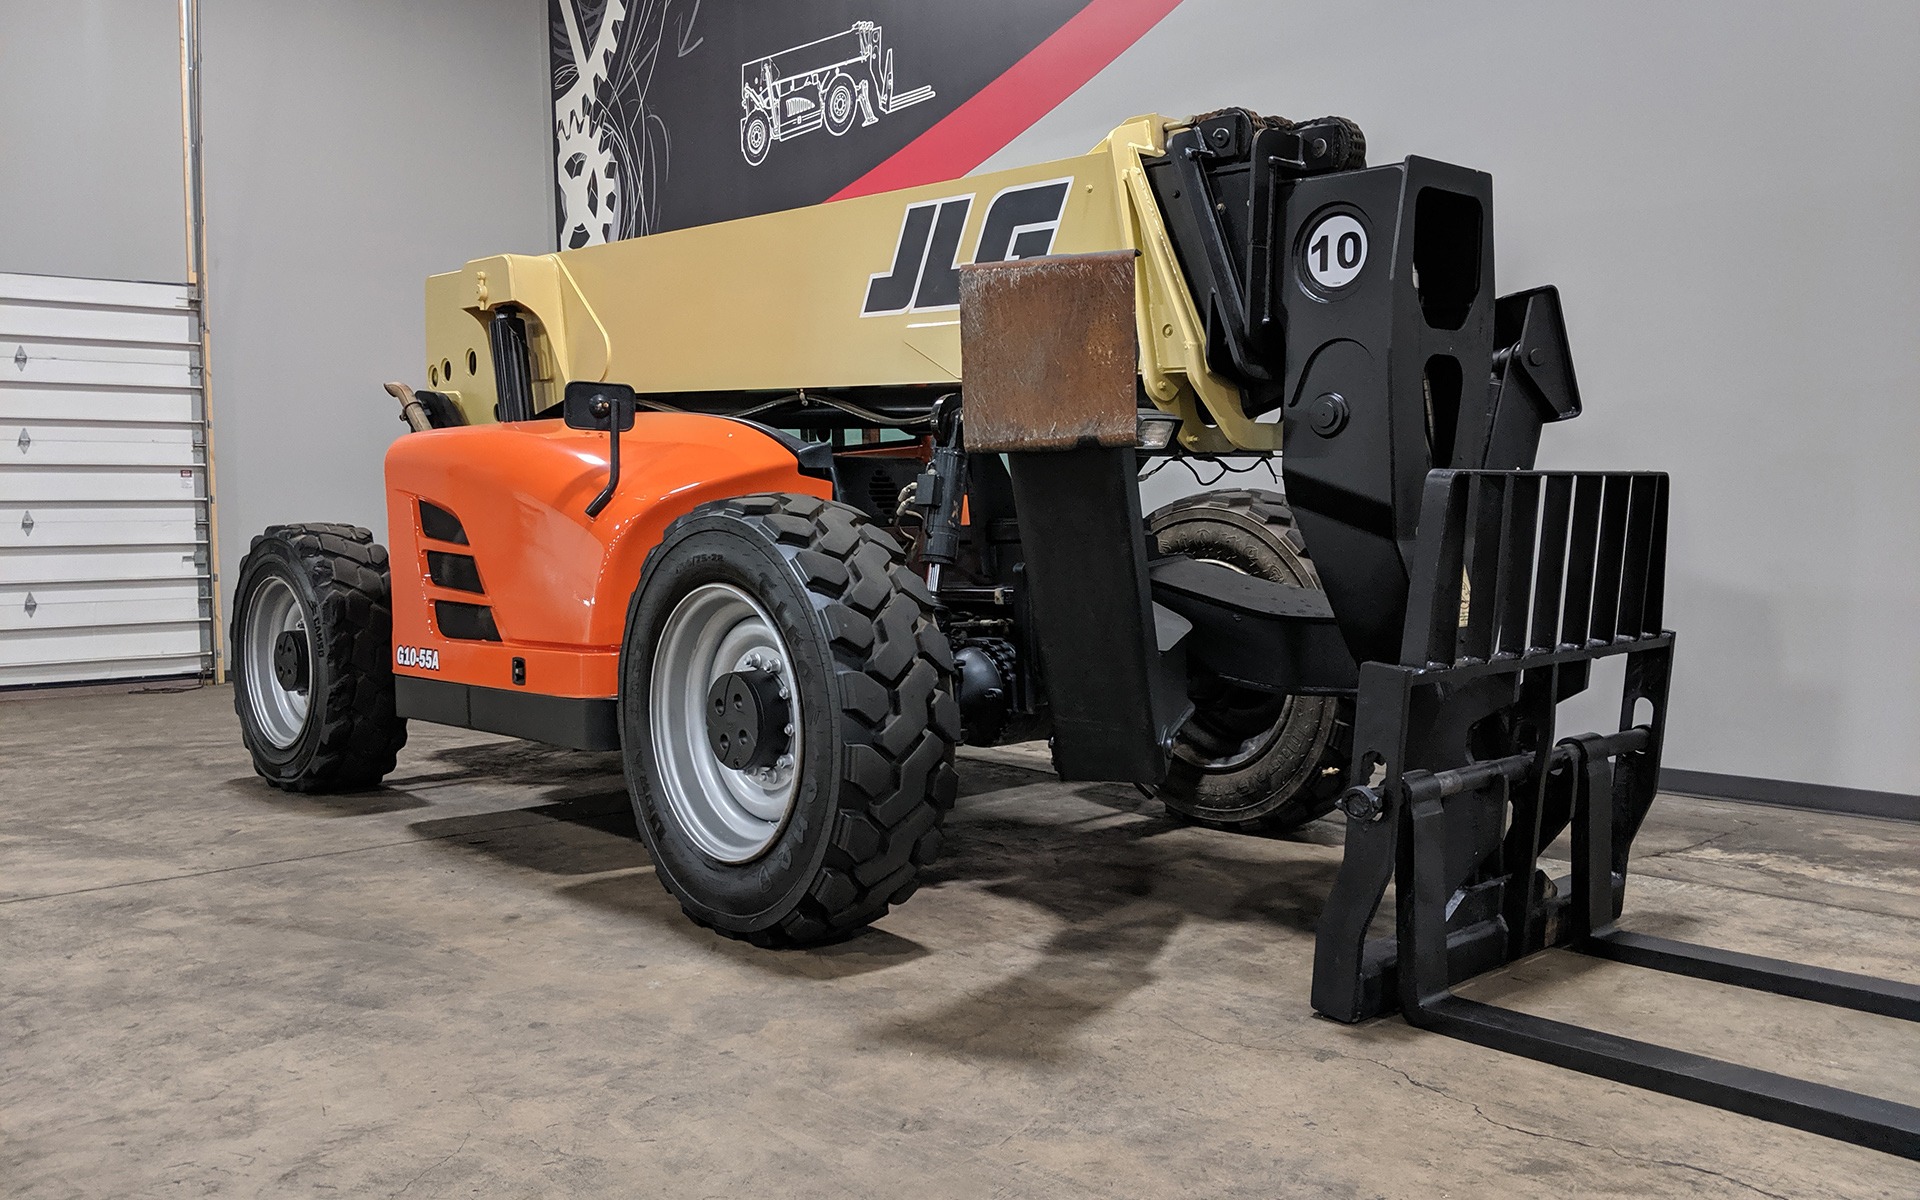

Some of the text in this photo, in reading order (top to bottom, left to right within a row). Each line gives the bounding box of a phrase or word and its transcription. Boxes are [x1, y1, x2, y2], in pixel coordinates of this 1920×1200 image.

[860, 176, 1075, 318] JLG
[1312, 232, 1362, 272] 10
[397, 645, 440, 671] G10-55A
